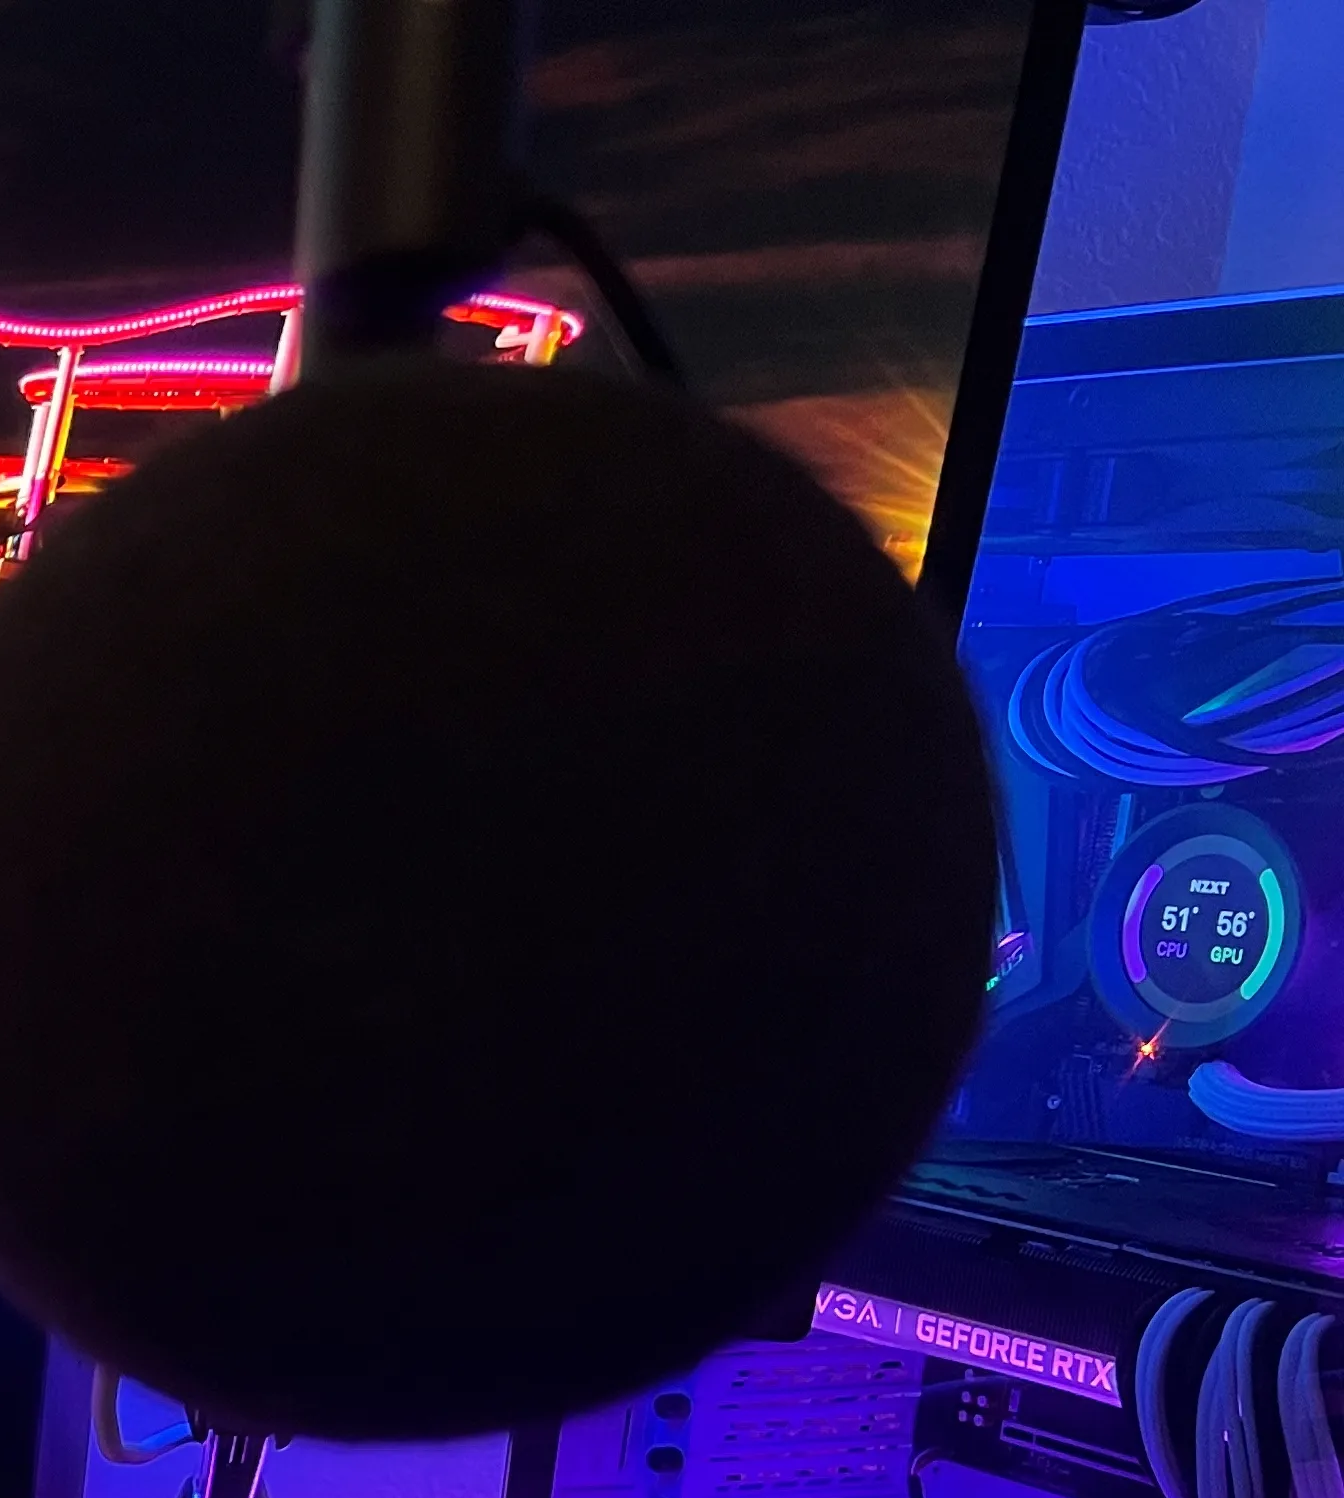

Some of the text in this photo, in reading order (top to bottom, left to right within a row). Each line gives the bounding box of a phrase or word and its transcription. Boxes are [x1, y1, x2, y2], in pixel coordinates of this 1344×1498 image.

[1190, 879, 1230, 895] NZXT
[1156, 941, 1188, 958] CPU
[1210, 946, 1244, 965] GPU
[816, 1290, 1115, 1391] VGA GEFORCE RTX
